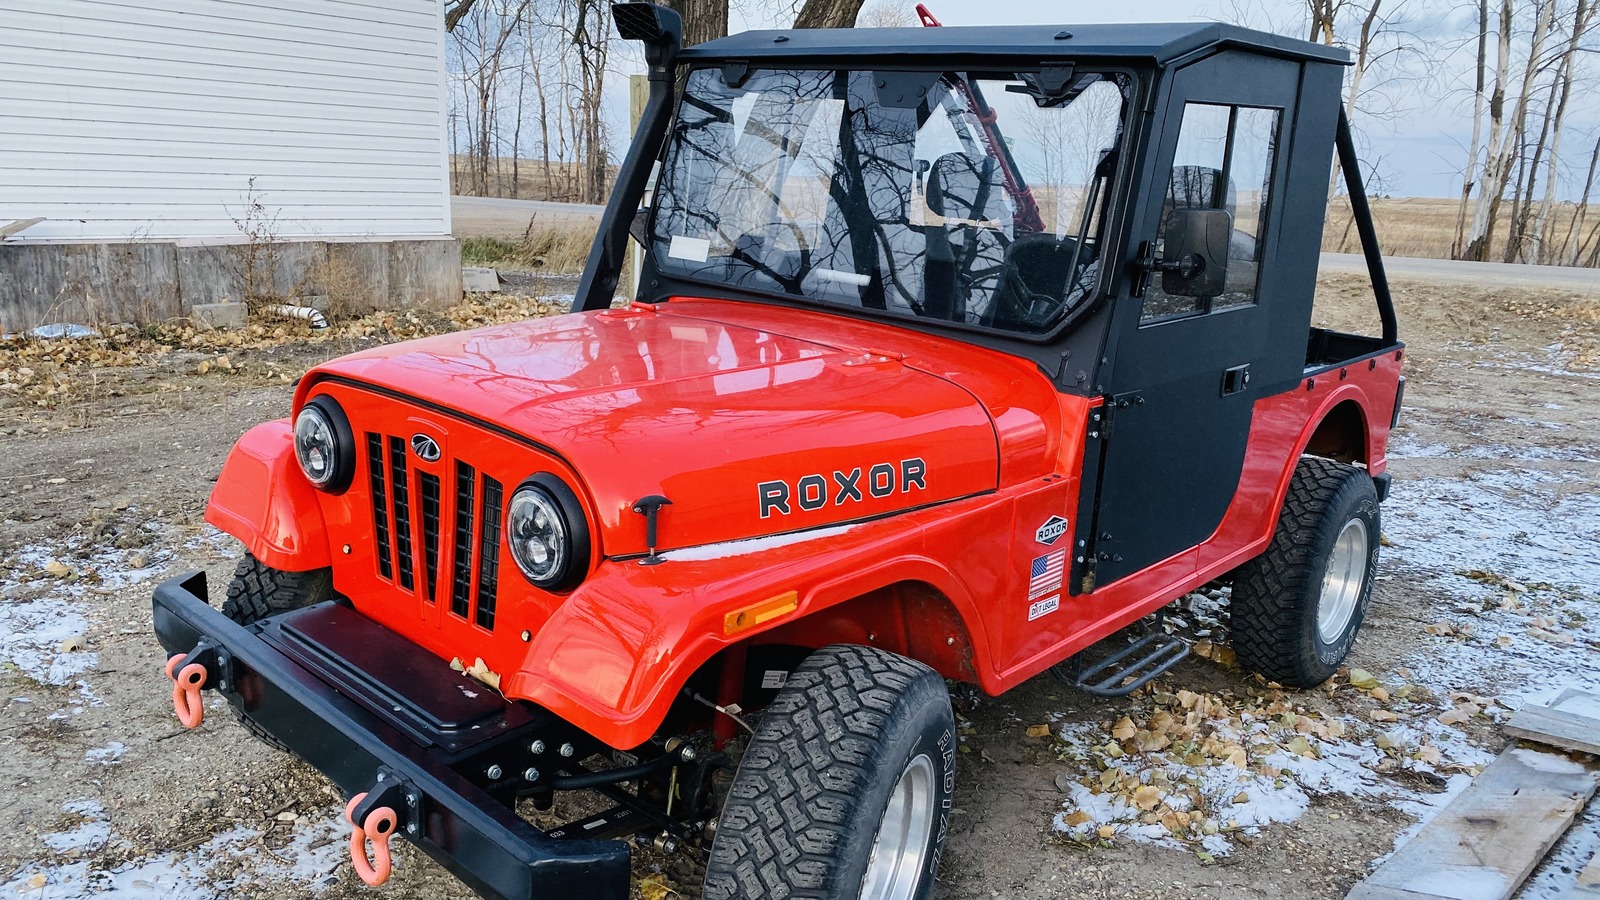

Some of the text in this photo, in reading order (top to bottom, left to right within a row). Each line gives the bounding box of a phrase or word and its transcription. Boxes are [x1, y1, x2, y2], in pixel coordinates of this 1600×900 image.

[757, 457, 926, 519] ROXOR
[1038, 522, 1066, 539] ROXOR
[929, 729, 954, 875] RADIAL
